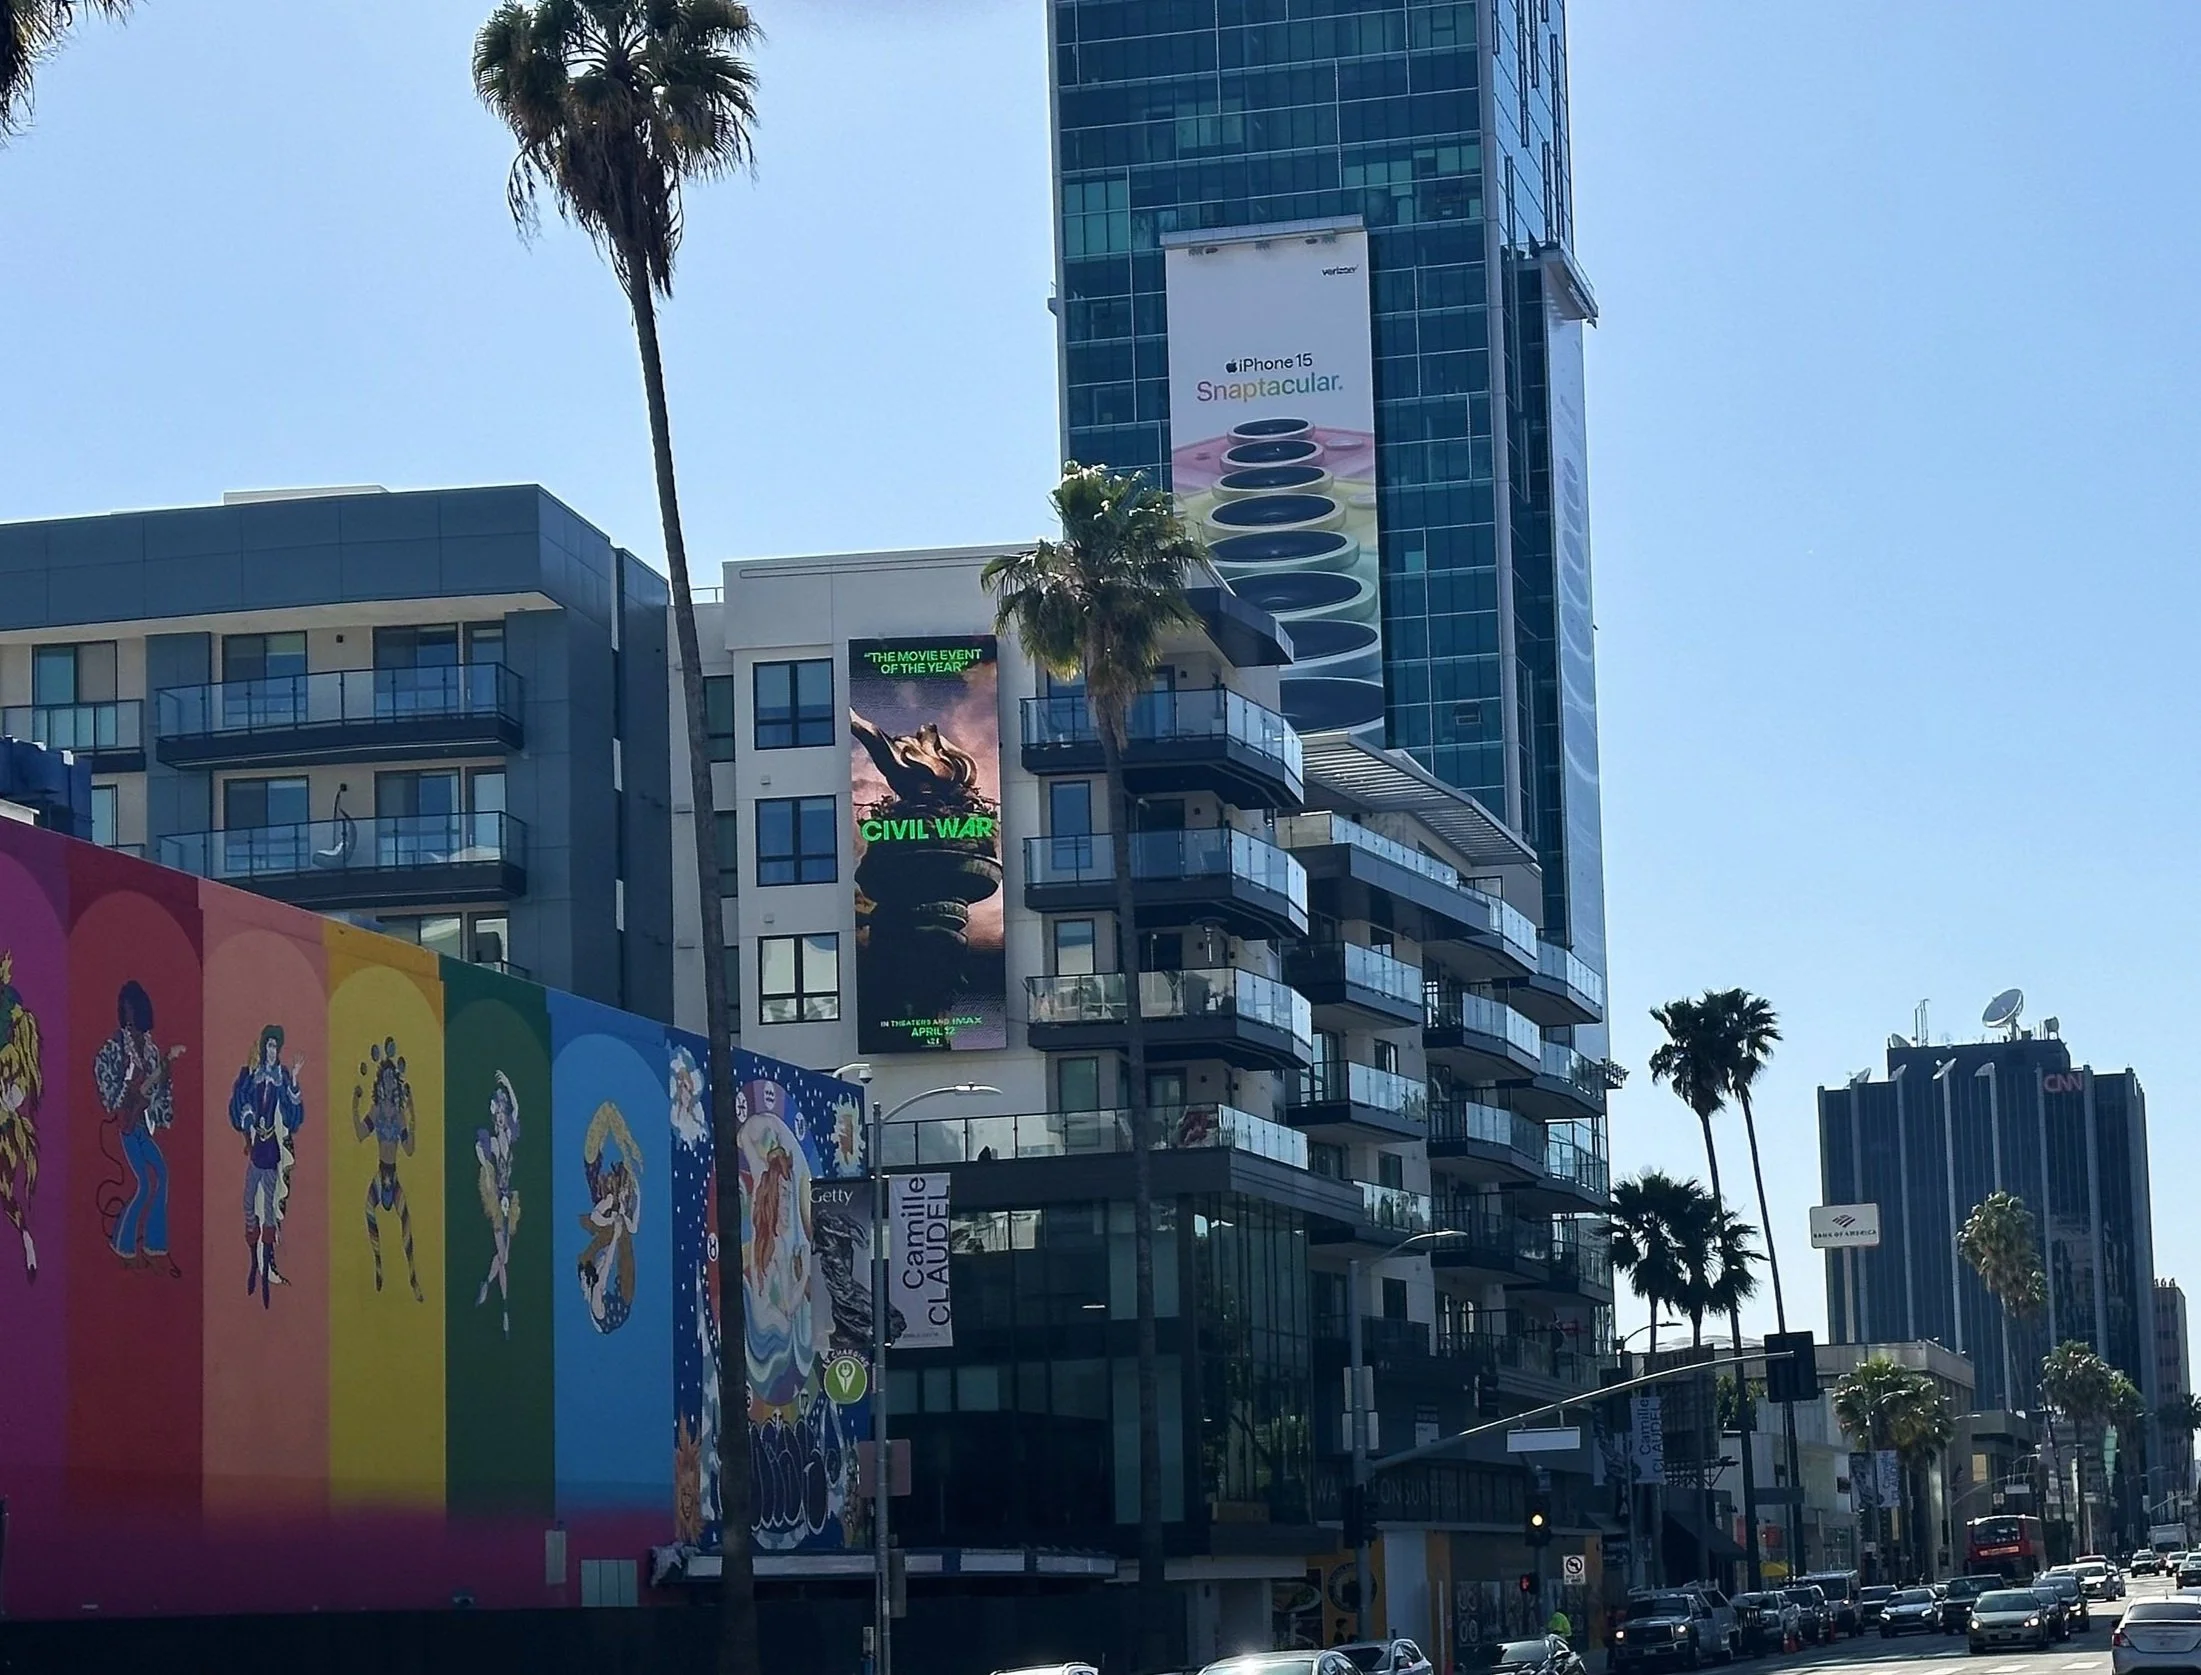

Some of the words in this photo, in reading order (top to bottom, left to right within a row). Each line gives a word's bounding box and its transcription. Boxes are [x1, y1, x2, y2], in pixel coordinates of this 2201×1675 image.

[1321, 264, 1357, 276] verizon
[1239, 356, 1293, 373] iPhone
[1295, 353, 1313, 367] 15
[1196, 372, 1343, 403] Snaptacular.
[897, 650, 939, 662] MOVIE
[940, 649, 982, 661] EVENT
[881, 664, 898, 674] OF
[901, 663, 926, 674] THE
[861, 819, 929, 842] CIVIL
[935, 816, 993, 839] WAR
[880, 1020, 889, 1028] IN
[933, 1018, 950, 1026] AND
[952, 1016, 983, 1026] IMAX
[911, 1026, 944, 1037] APRIL
[2044, 1072, 2083, 1093] CNN
[810, 1187, 854, 1205] Getty
[900, 1176, 926, 1290] Camille
[1813, 1231, 1833, 1239] BANK
[1844, 1229, 1877, 1237] AMERICA
[925, 1184, 950, 1326] CLAUDEL
[1637, 1399, 1651, 1455] Camille
